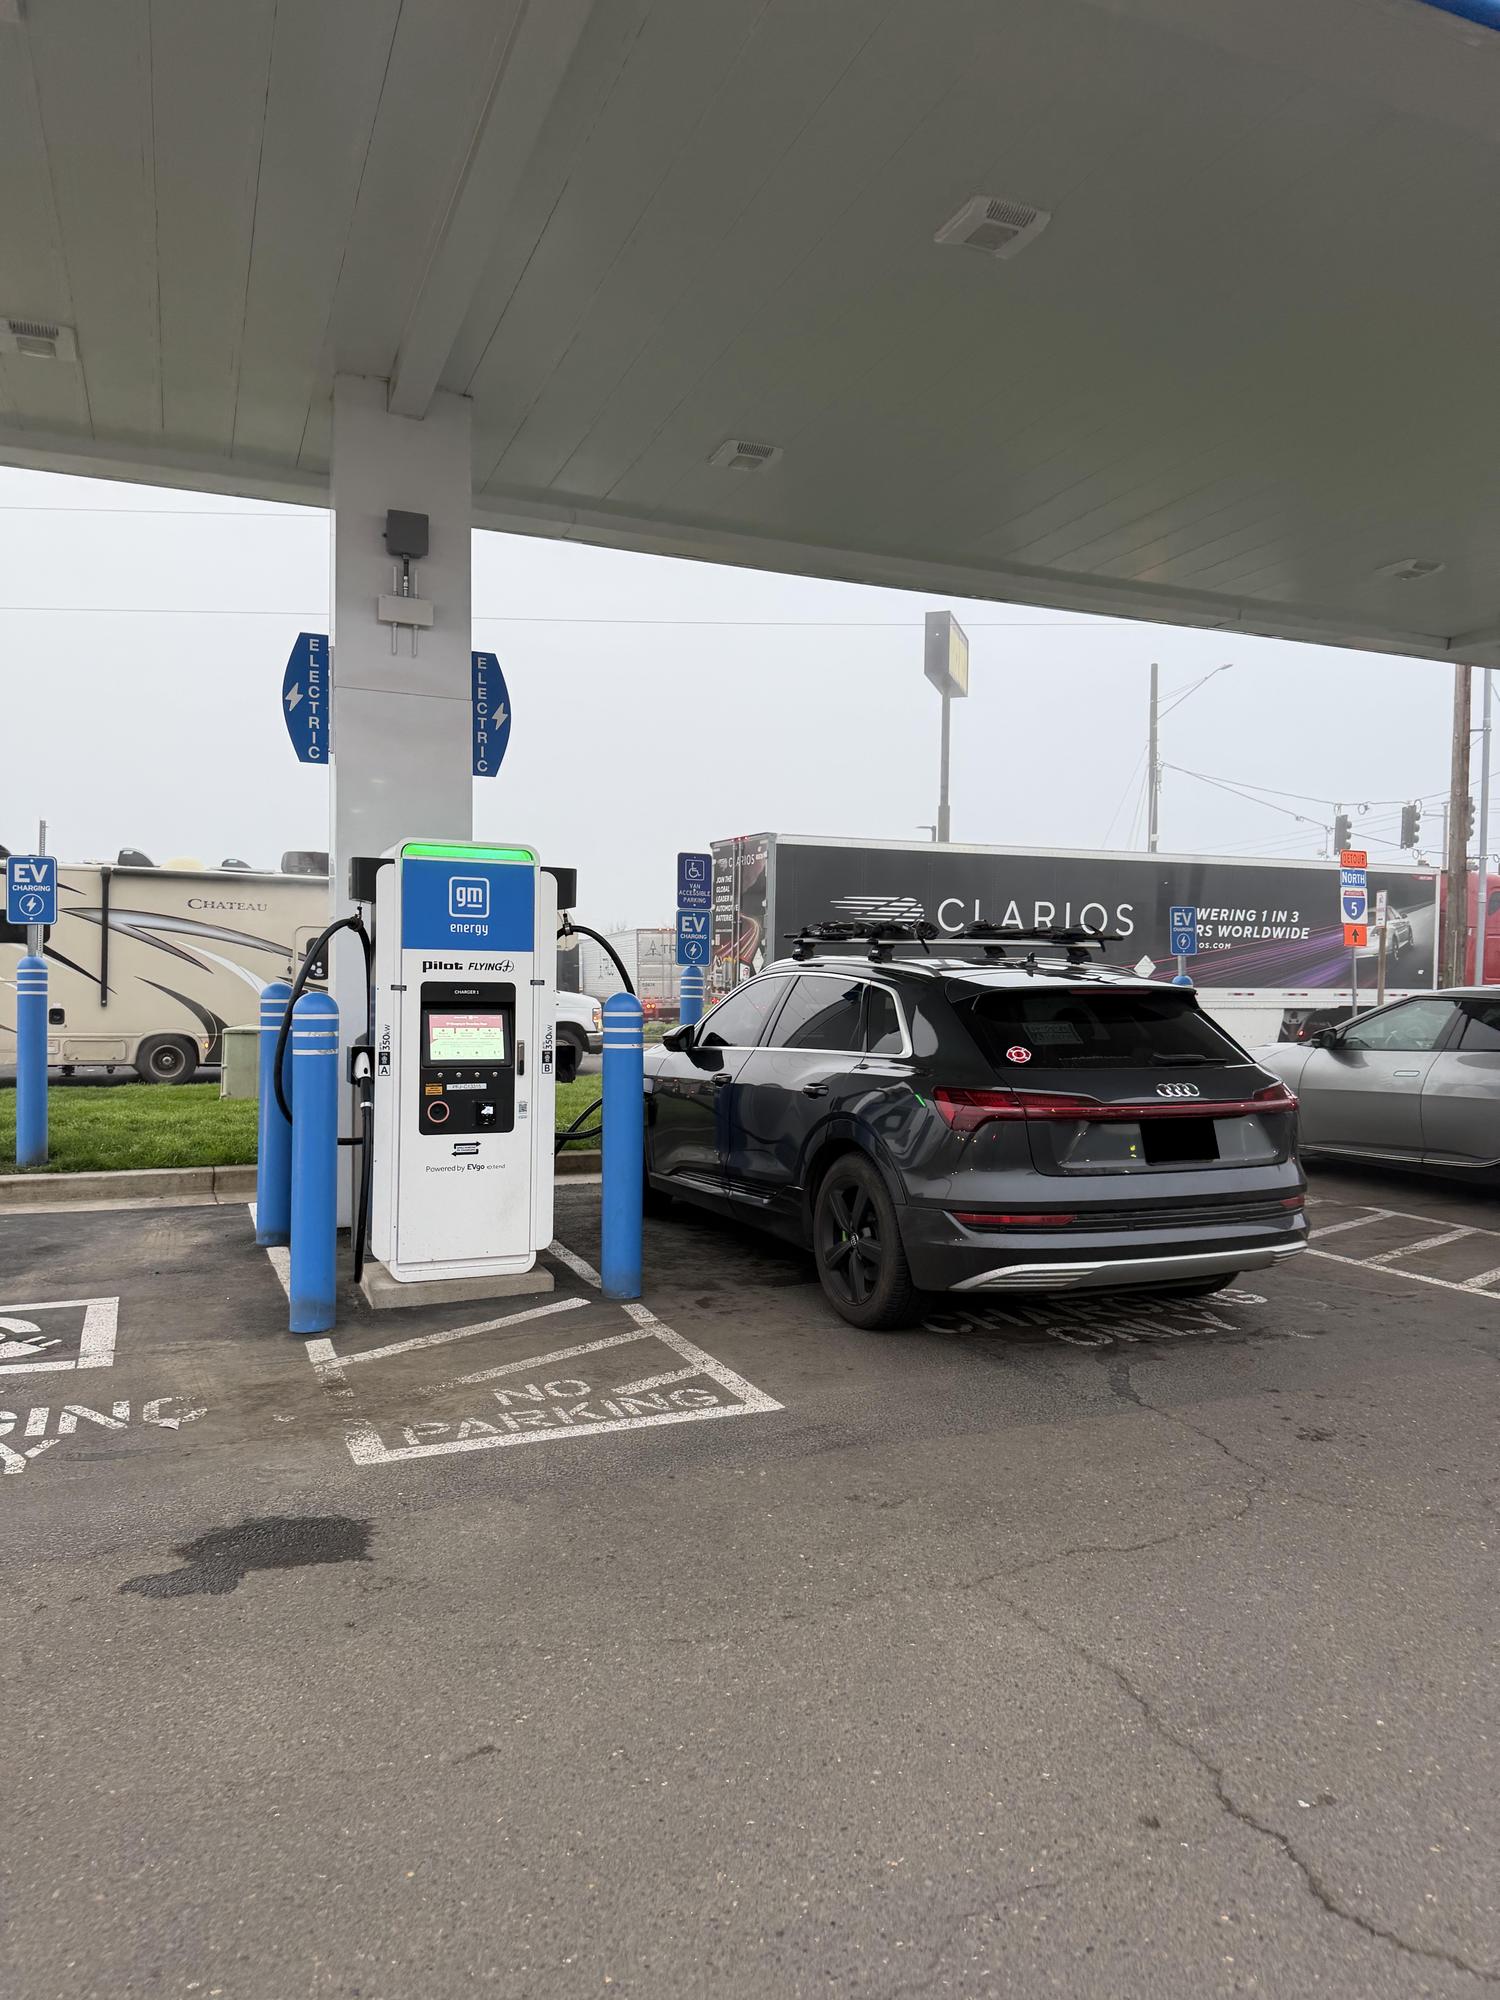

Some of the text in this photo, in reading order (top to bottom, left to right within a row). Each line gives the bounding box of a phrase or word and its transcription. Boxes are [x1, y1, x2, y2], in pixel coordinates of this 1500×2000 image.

[308, 638, 321, 759] ELECTRIC
[476, 656, 488, 772] ELECTRIC
[1343, 854, 1365, 864] DETOUR
[13, 863, 48, 883] EV
[1341, 871, 1365, 884] NORTH
[12, 884, 51, 892] CHARGING
[456, 886, 483, 907] gm
[187, 898, 268, 912] CHATEAU
[1351, 901, 1358, 916] 5
[936, 898, 1135, 936] CLARIOS
[1174, 912, 1192, 926] EV
[1196, 907, 1300, 923] WERING 1 IN 3
[450, 923, 489, 936] energy
[681, 916, 705, 932] EV
[1196, 924, 1310, 939] RS WORLDWIDE
[468, 962, 502, 971] FLYING
[380, 1066, 388, 1074] A
[544, 1064, 551, 1072] B
[425, 1165, 456, 1173] Powered
[456, 1165, 465, 1173] by
[467, 1163, 485, 1172] EVgo
[1046, 1311, 1241, 1346] ONLY
[492, 1379, 592, 1406] NO
[0, 1396, 208, 1437] ING
[399, 1388, 719, 1445] PARKING
